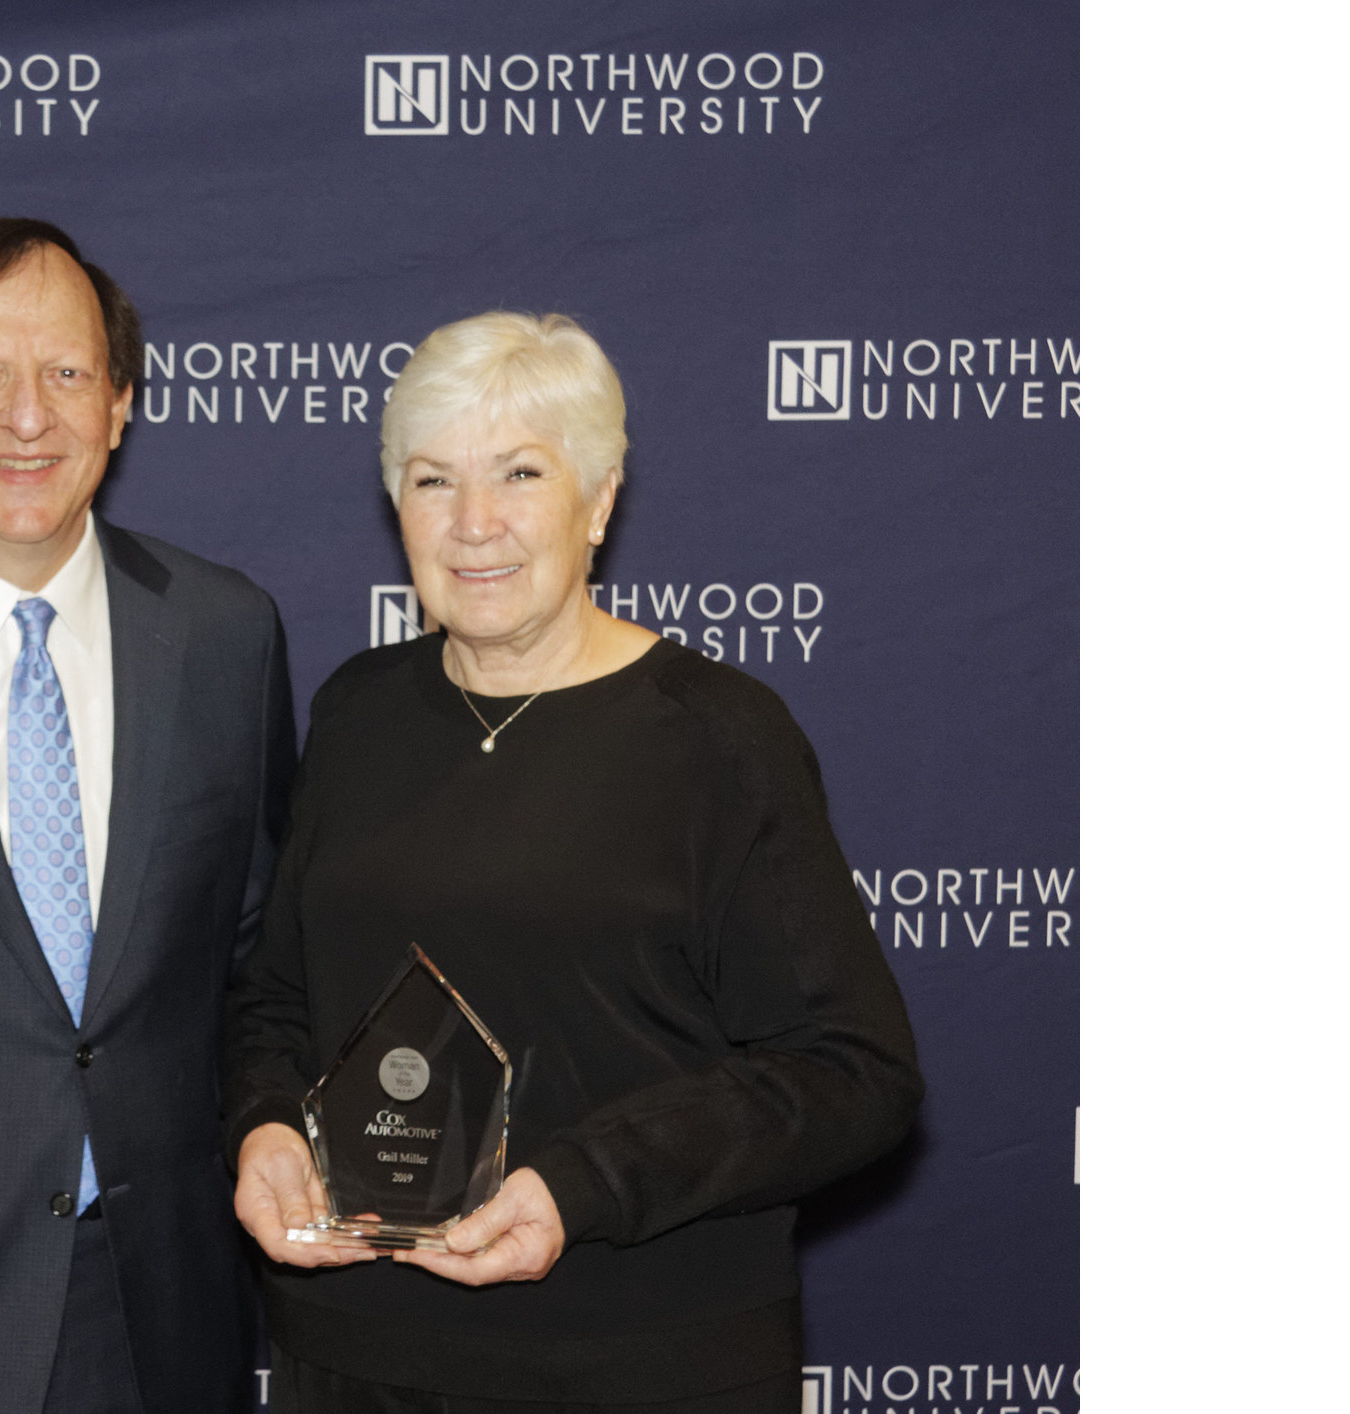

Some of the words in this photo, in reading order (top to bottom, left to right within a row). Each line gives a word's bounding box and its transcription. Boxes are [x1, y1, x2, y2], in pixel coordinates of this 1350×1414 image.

[460, 51, 824, 92] NORTHWOOD
[460, 96, 822, 136] UNIVERSITY
[144, 385, 391, 423] UNIVER
[852, 867, 1075, 906] NORTHW
[377, 1151, 398, 1163] Gail
[400, 1152, 429, 1165] Miller
[391, 1172, 414, 1183] 2019
[843, 1364, 1079, 1401] NORTHW
